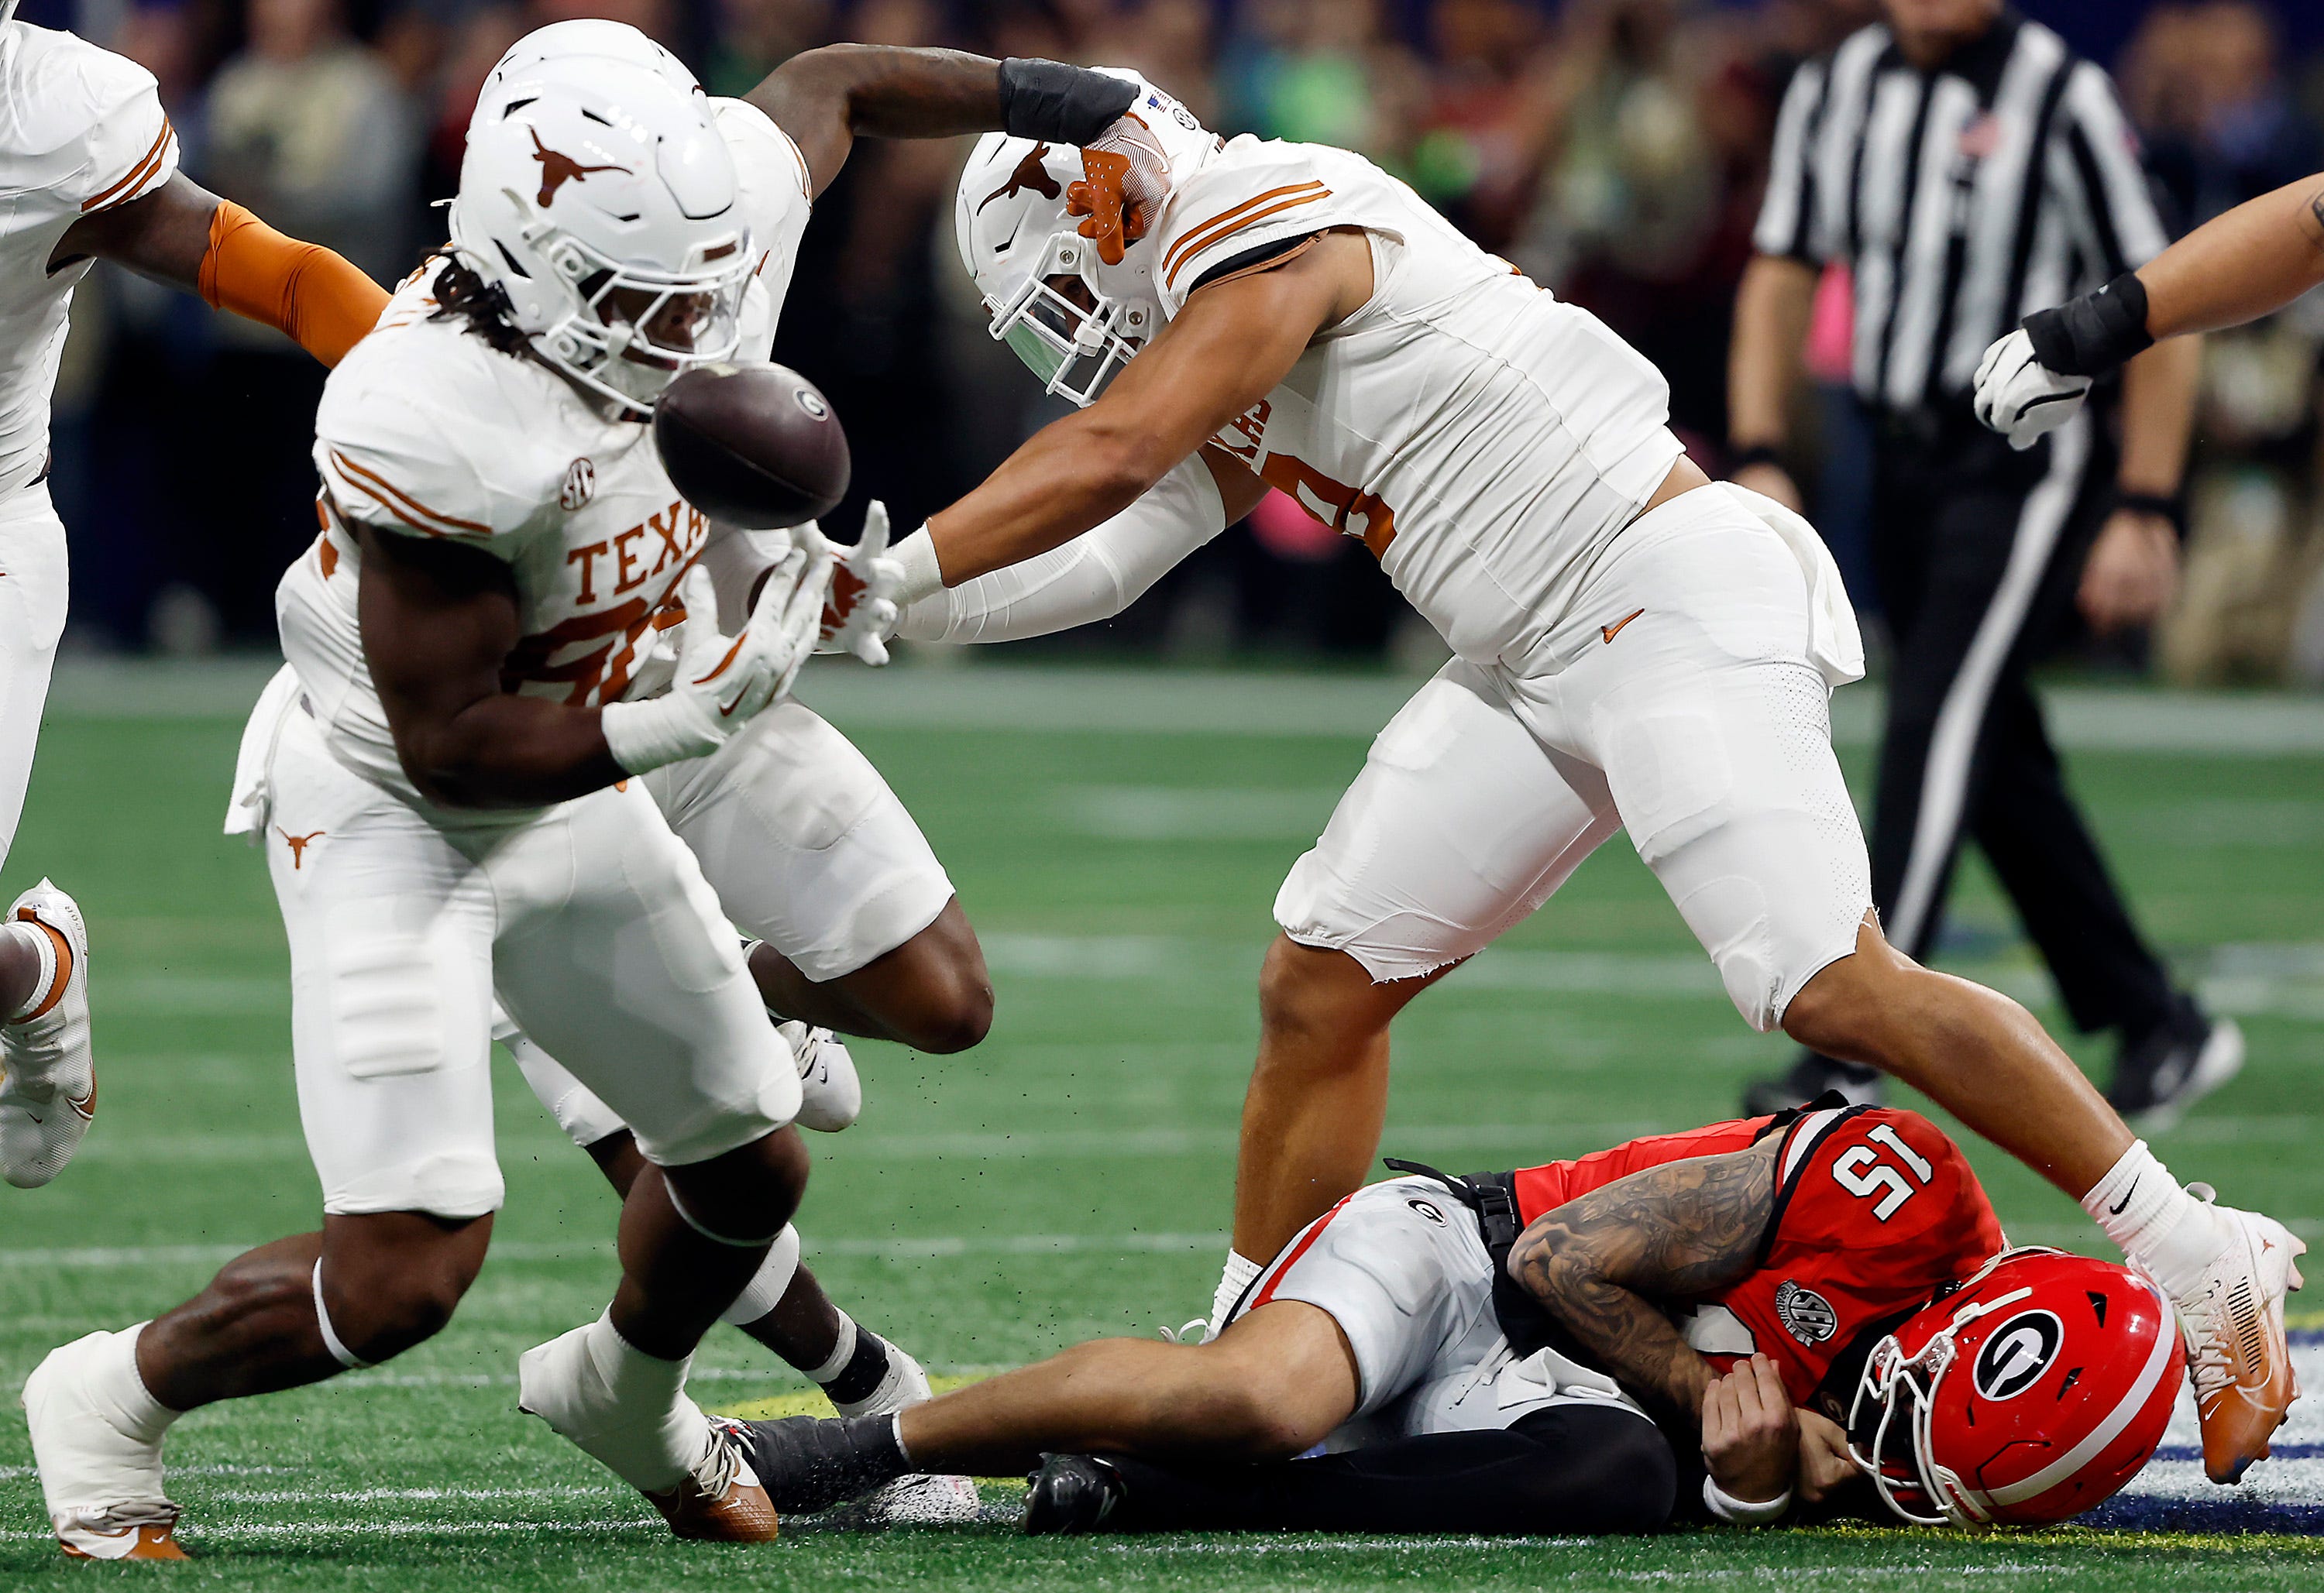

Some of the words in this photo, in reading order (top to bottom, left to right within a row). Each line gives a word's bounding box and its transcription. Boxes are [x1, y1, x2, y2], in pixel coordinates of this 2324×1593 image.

[799, 390, 829, 417] G
[566, 500, 705, 606] TEXA
[1832, 1123, 1933, 1223] 15
[1414, 1202, 1446, 1224] G
[1789, 1291, 1834, 1339] SEC
[1980, 1323, 2047, 1399] G
